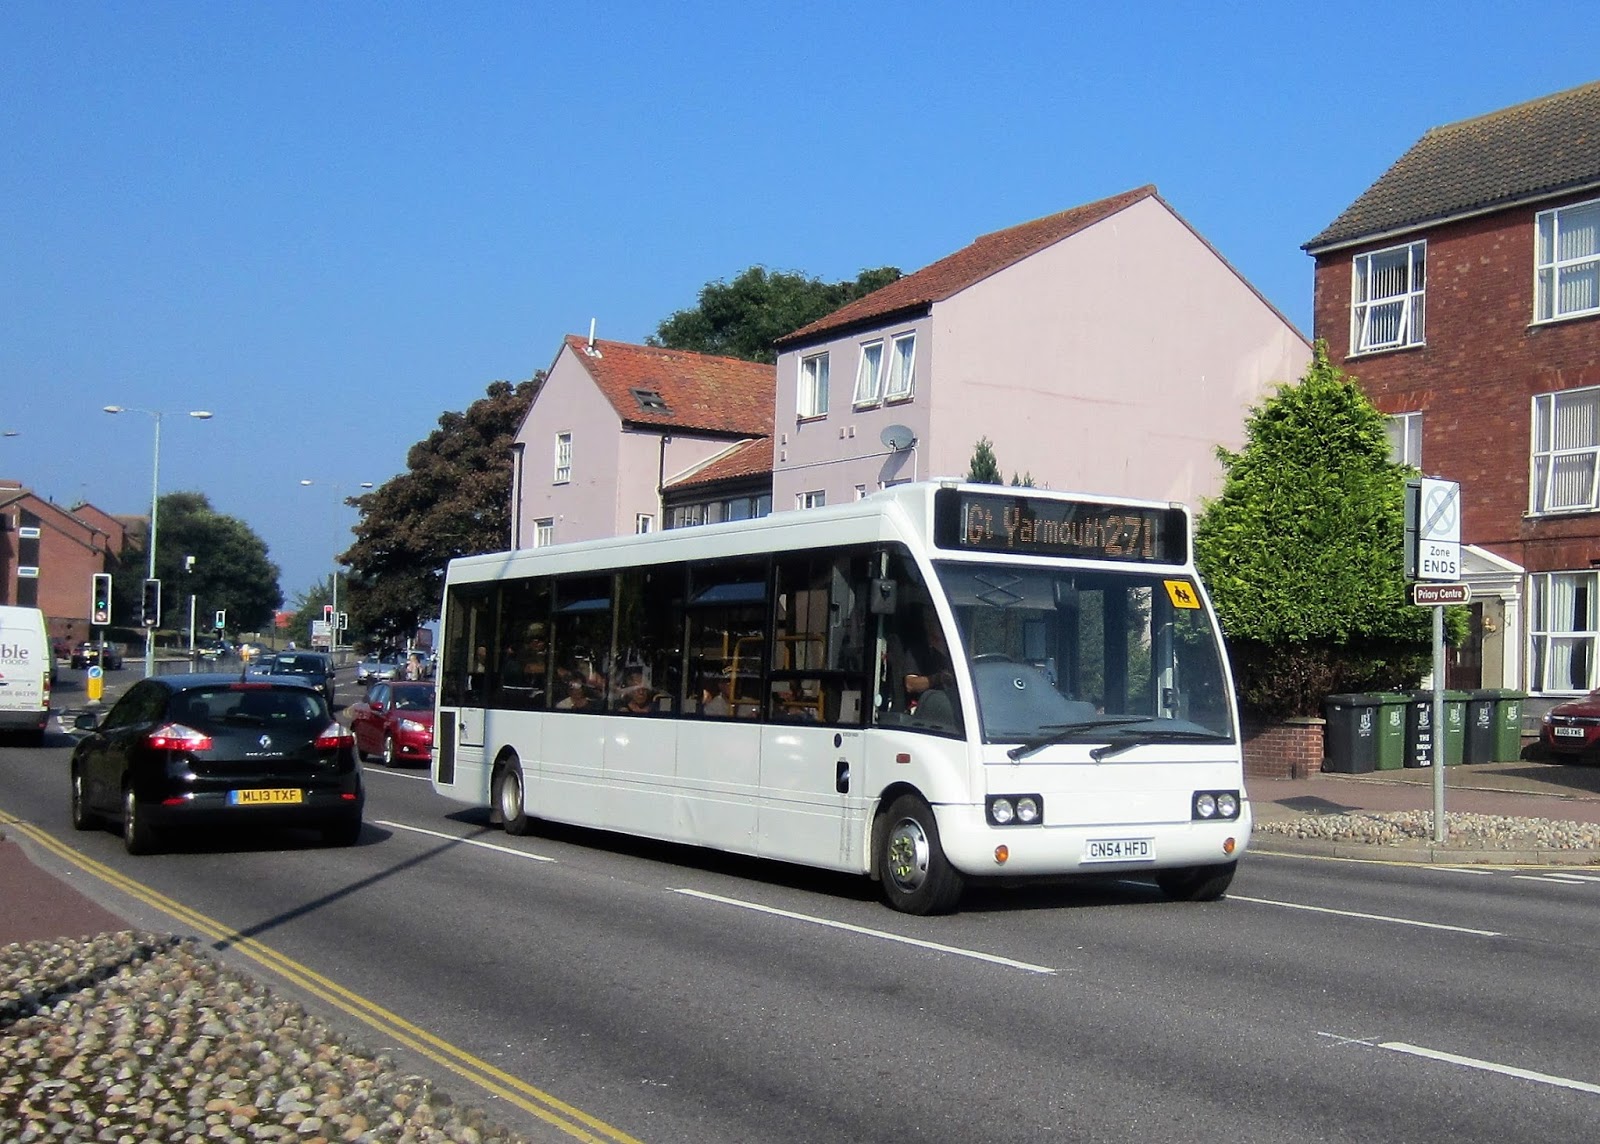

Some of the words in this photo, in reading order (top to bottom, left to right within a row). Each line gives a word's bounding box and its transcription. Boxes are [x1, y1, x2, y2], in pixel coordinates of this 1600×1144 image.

[968, 503, 994, 545] Gt
[1003, 506, 1106, 549] Yarmouth
[1105, 515, 1155, 559] 271
[1430, 546, 1451, 557] Zone
[1424, 560, 1456, 574] ENDS
[1418, 588, 1438, 600] Priory
[1440, 589, 1462, 599] Centre
[243, 791, 270, 801] ML13
[273, 790, 296, 801] TXF
[1091, 843, 1121, 857] CN54
[1124, 841, 1148, 856] HFD
